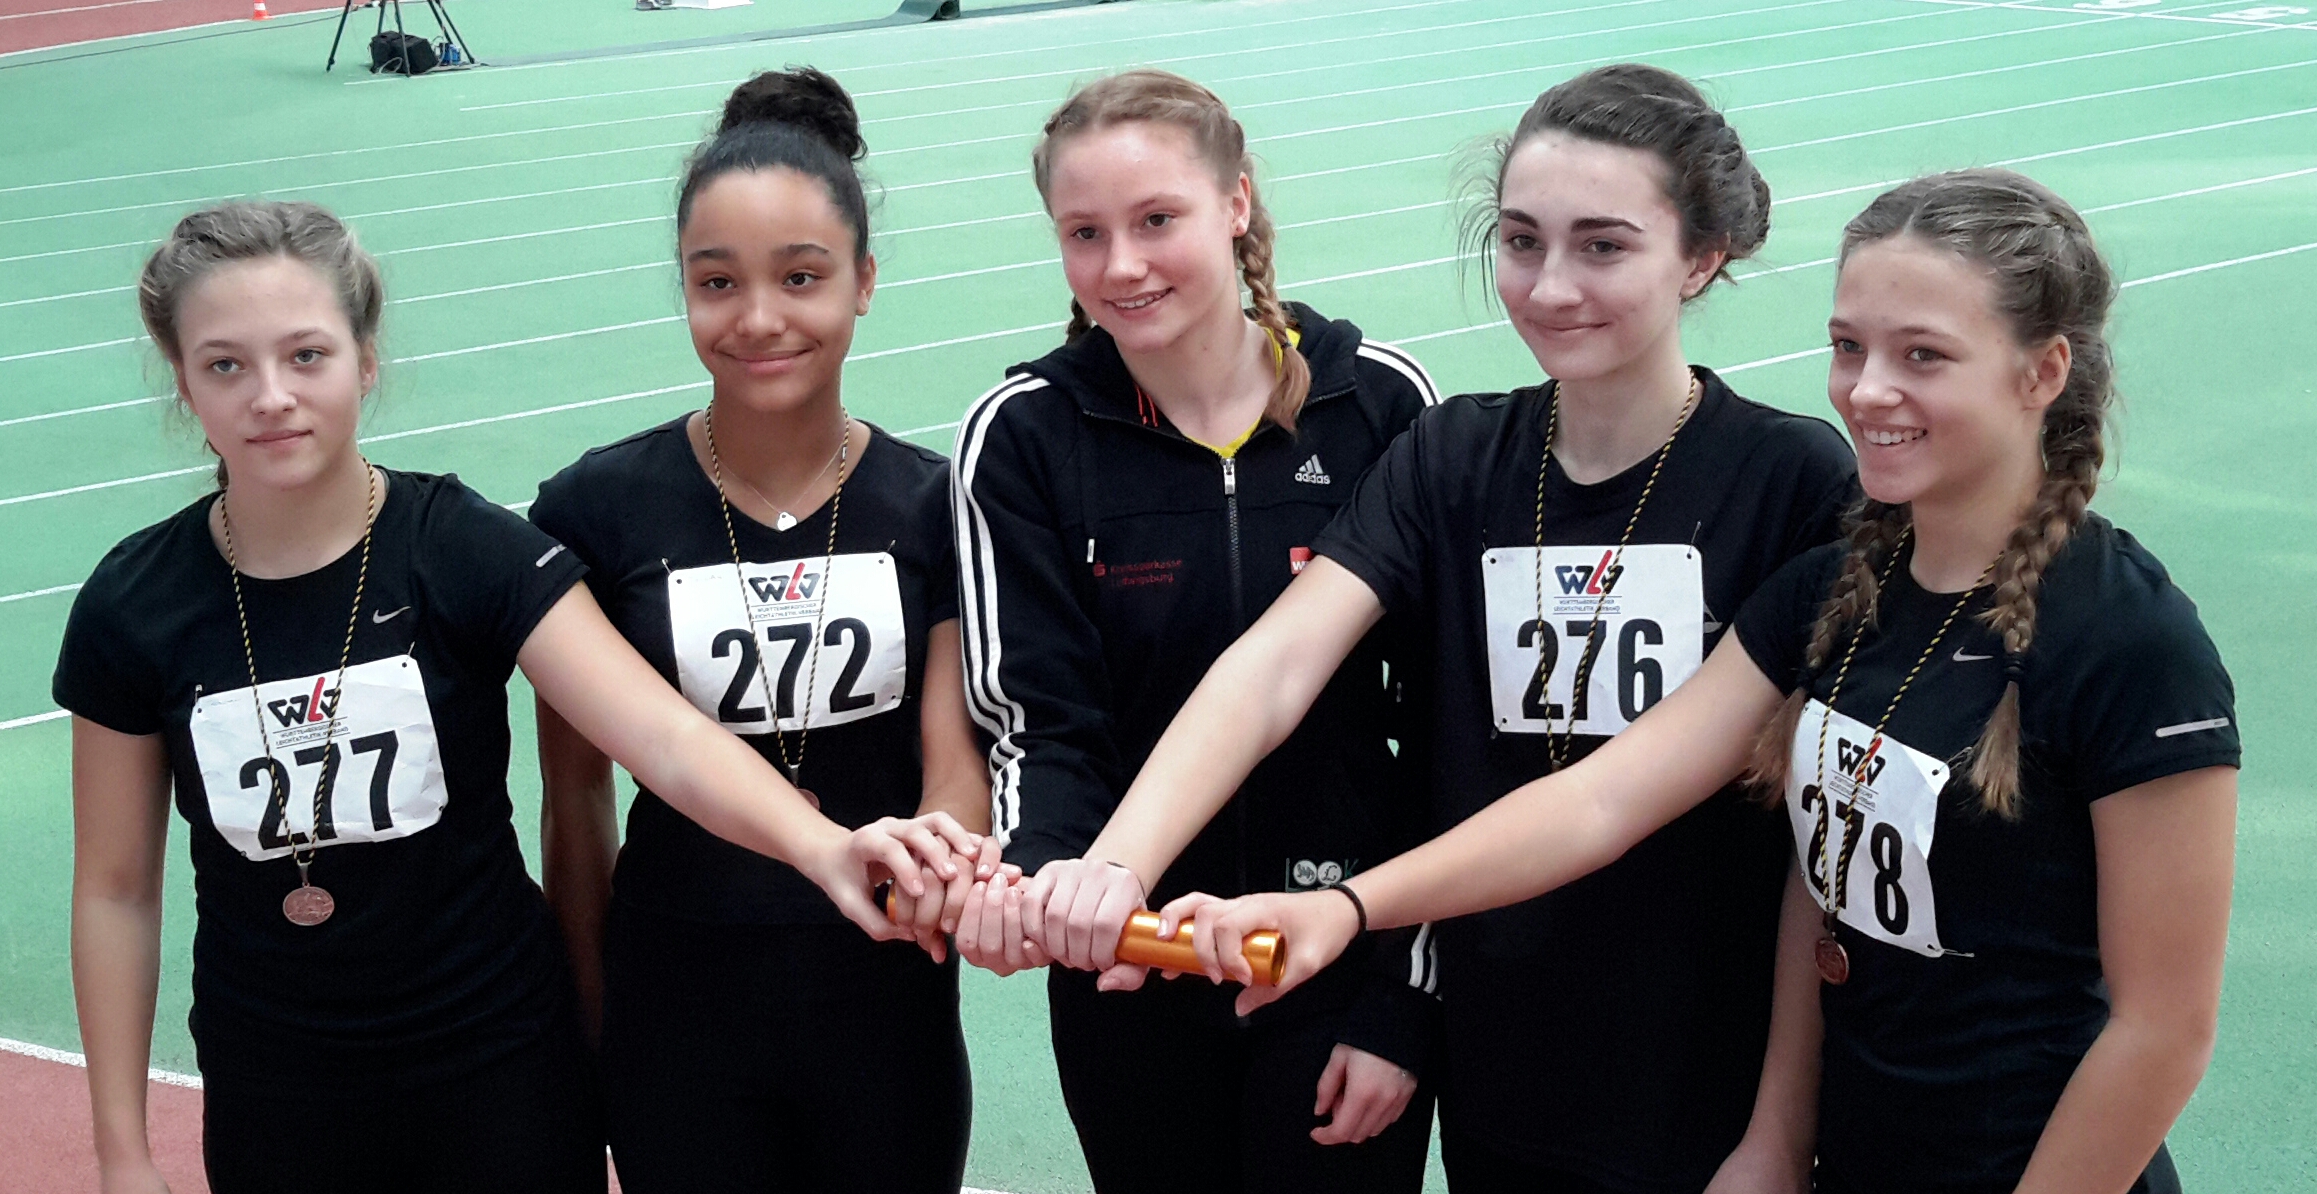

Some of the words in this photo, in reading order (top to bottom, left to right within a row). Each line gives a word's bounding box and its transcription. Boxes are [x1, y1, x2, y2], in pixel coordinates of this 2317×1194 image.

[1294, 472, 1331, 485] adidas
[711, 617, 876, 723] 272
[1517, 618, 1664, 724] 276
[239, 729, 399, 851] 277
[1801, 783, 1909, 936] 278
